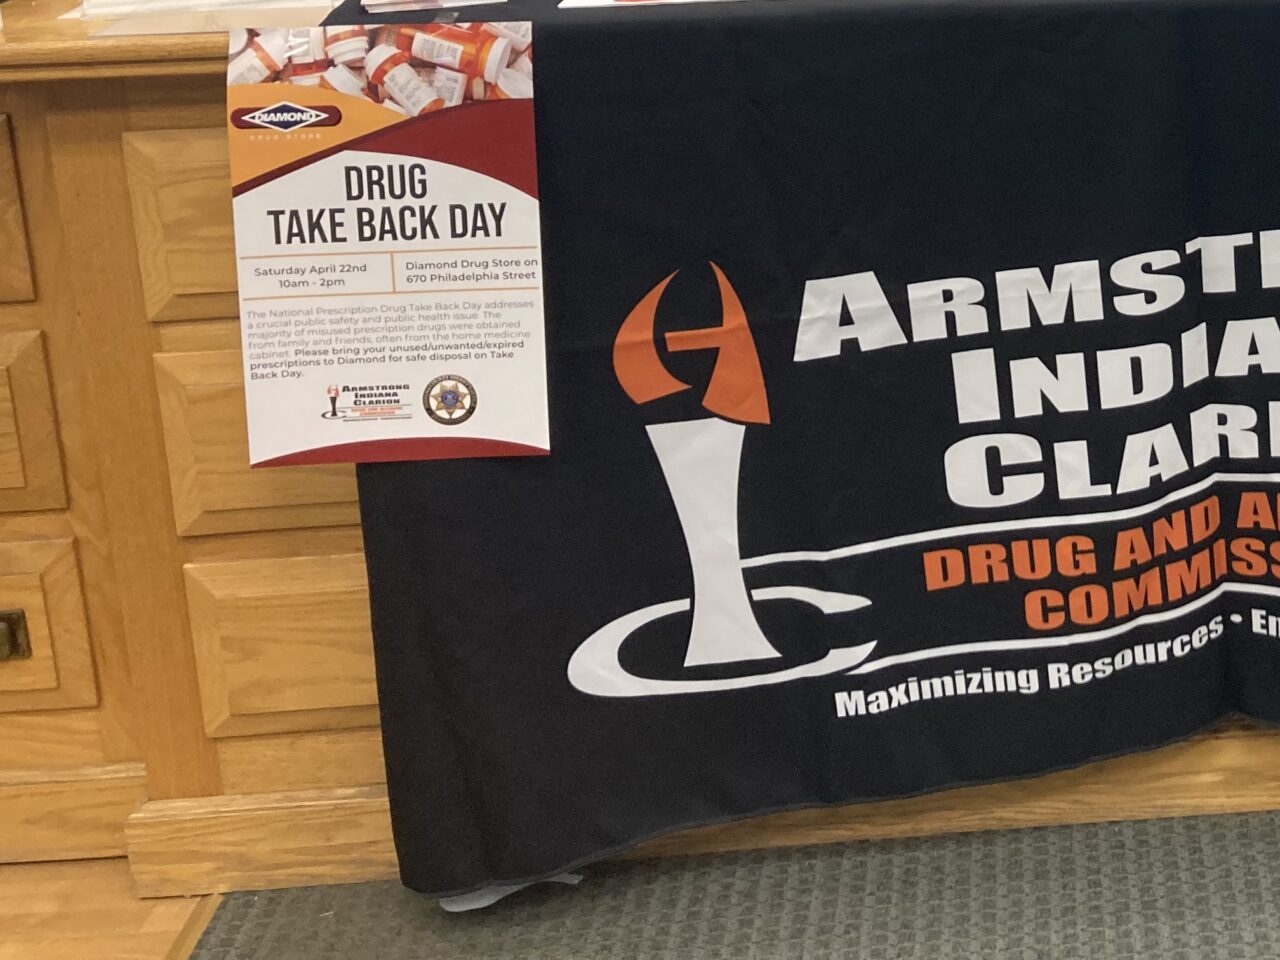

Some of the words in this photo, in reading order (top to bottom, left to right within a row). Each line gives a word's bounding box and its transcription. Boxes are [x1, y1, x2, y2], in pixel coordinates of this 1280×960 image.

[254, 111, 316, 122] DIAMOND
[344, 164, 427, 201] DRUG
[267, 208, 348, 245] TAKE
[357, 205, 439, 242] BACK
[449, 202, 506, 239] DAY
[254, 266, 306, 277] Saturday
[309, 265, 336, 275] April
[339, 264, 367, 273] 22nd
[406, 260, 457, 270] Diamond
[461, 260, 489, 269] Drug
[492, 259, 520, 267] Store
[279, 279, 309, 288] 10am
[320, 278, 345, 288] 2pm
[406, 274, 426, 283] 670
[430, 272, 499, 282] Philadelphia
[502, 271, 536, 279] Street
[246, 311, 266, 319] The
[269, 308, 313, 318] National
[316, 305, 378, 316] Prescription
[380, 304, 406, 313] Drug
[409, 303, 432, 311] Take
[435, 302, 460, 310] Back
[463, 302, 482, 310] Day
[484, 300, 534, 309] addresses
[294, 348, 328, 357] Please
[332, 346, 360, 356] bring
[362, 346, 386, 354] your
[389, 340, 524, 352] unused/unwanted/expired
[250, 358, 321, 371] prescriptions
[337, 356, 385, 365] Diamond
[389, 354, 402, 362] for
[429, 352, 471, 361] disposal
[490, 351, 514, 359] Take
[250, 372, 278, 380] Back
[281, 370, 304, 378] Day.
[342, 384, 410, 392] ARMSTRONG
[922, 536, 1098, 591] DRUG
[1112, 495, 1221, 571] AND
[835, 666, 1040, 718] Maximizing
[1048, 613, 1225, 689] Resources
